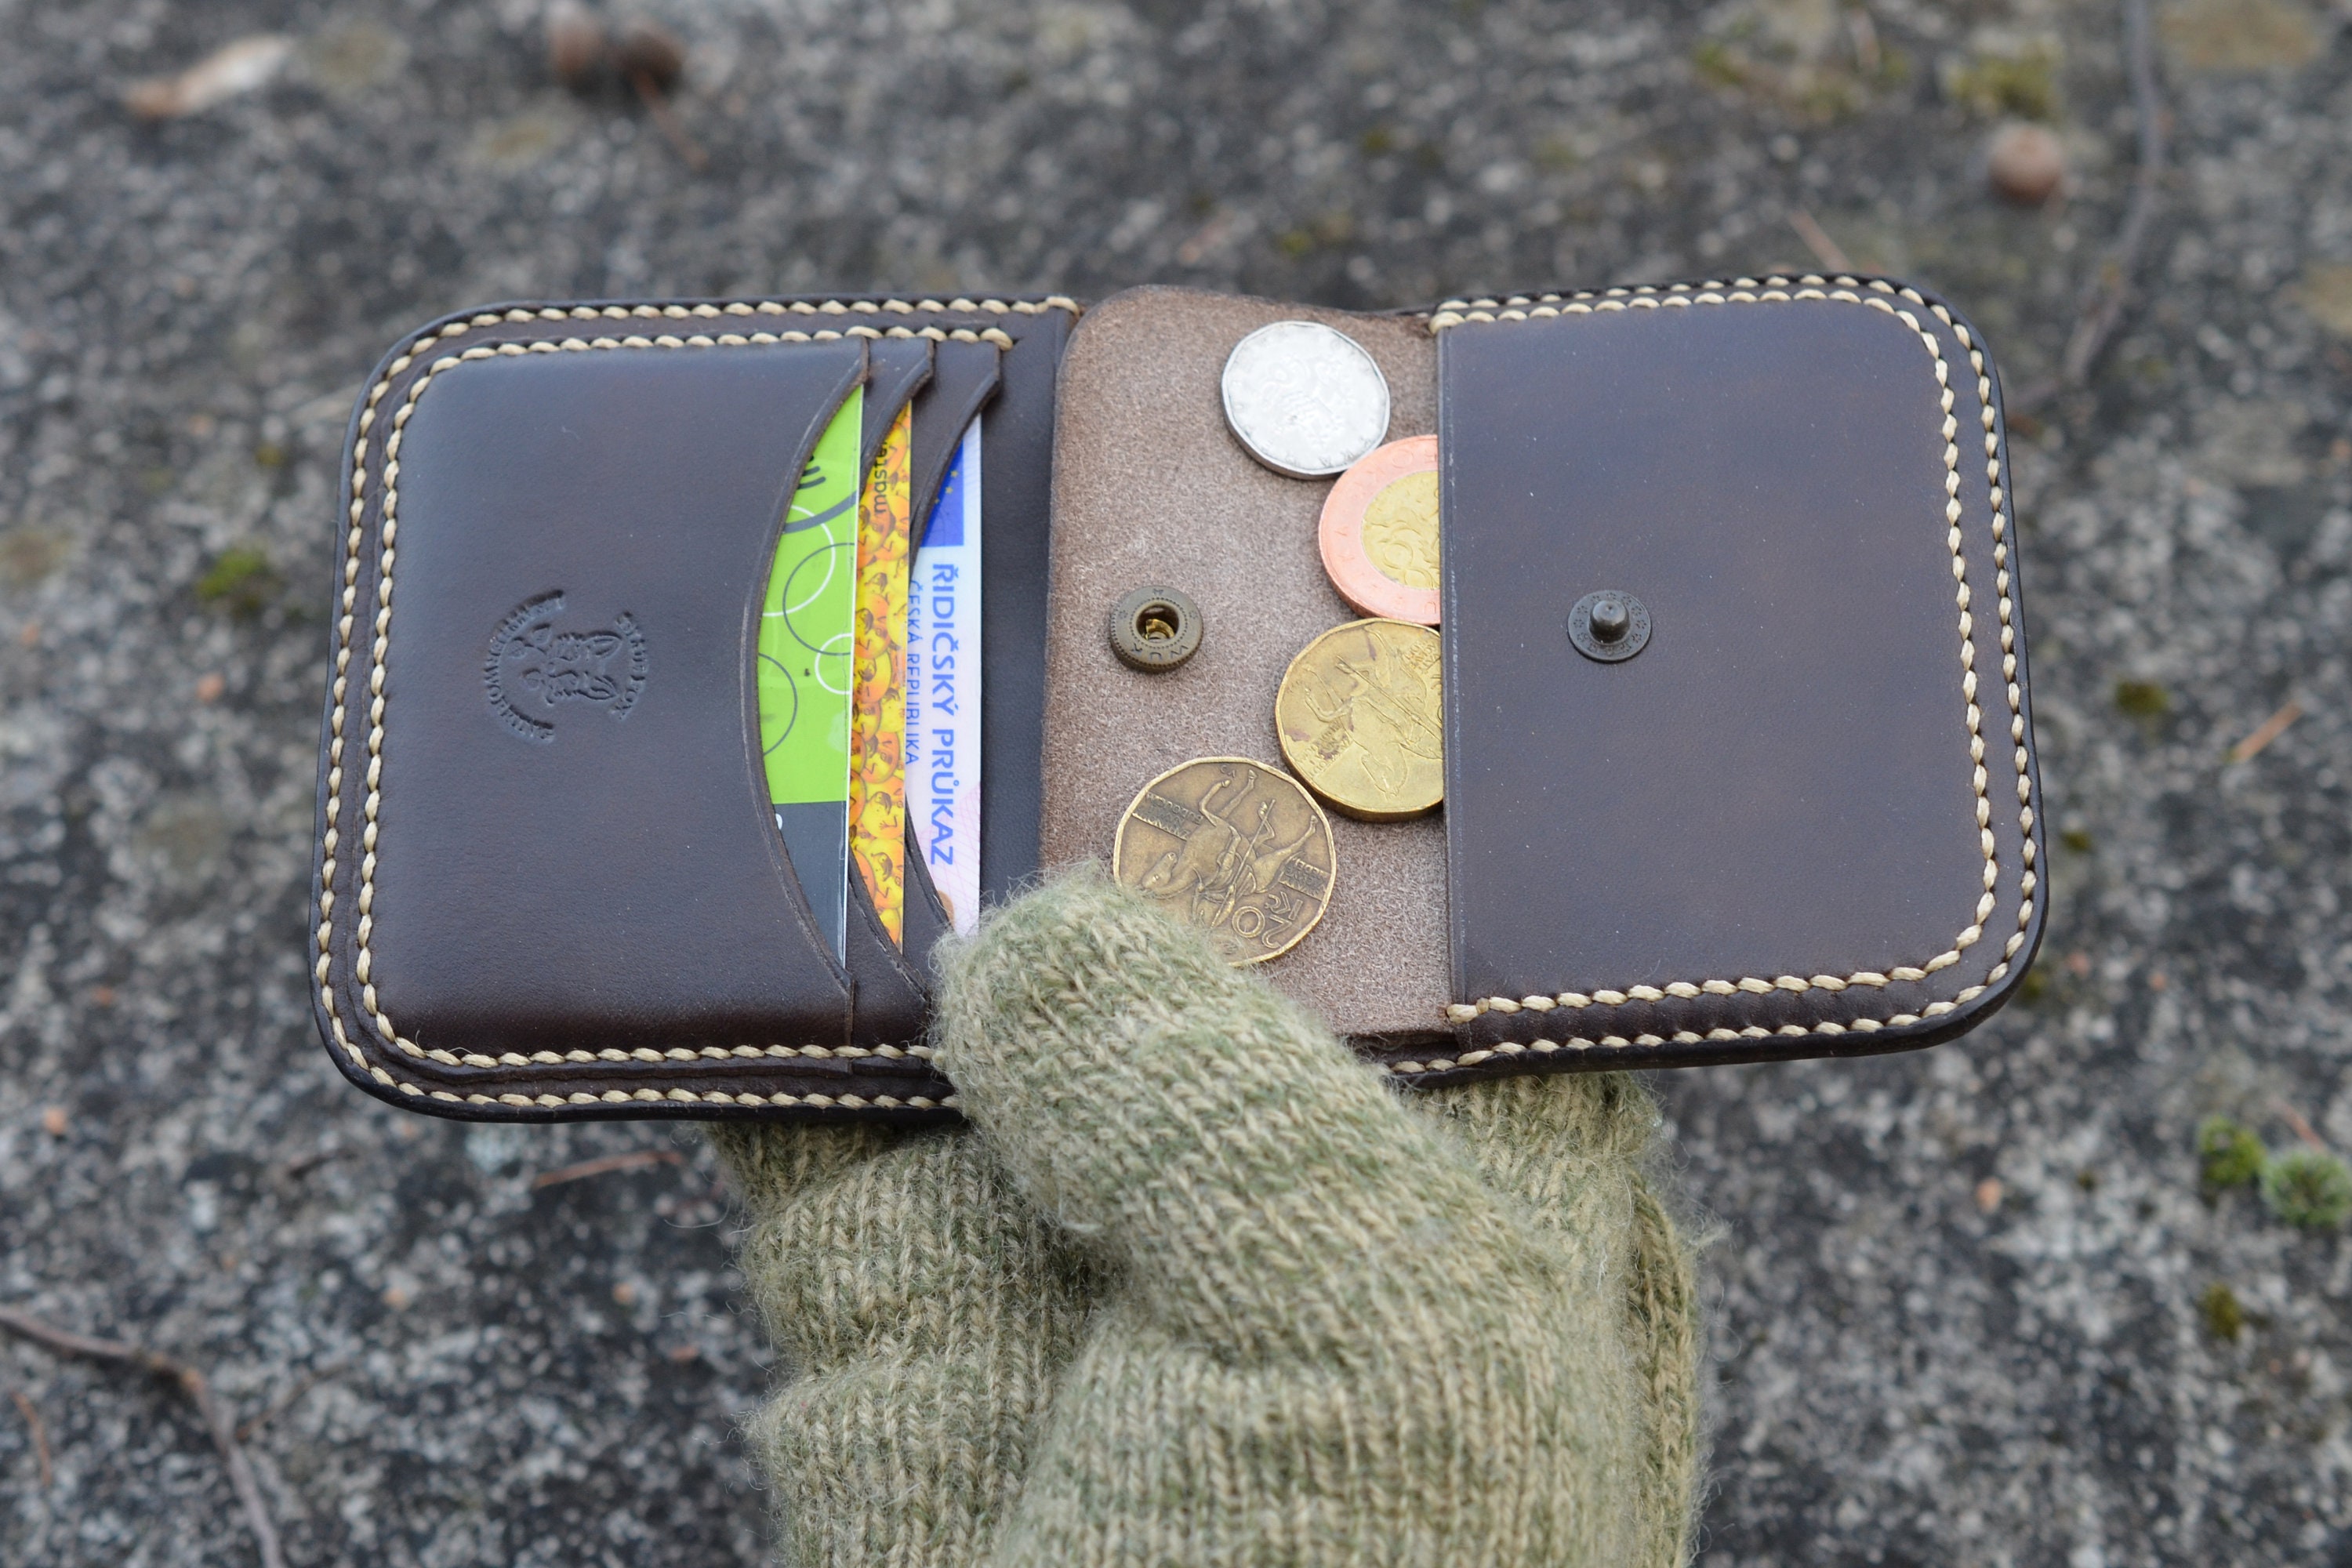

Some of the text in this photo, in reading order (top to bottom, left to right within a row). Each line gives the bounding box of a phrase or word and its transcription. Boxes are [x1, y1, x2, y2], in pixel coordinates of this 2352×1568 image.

[906, 579, 924, 644] ČESKÁ
[930, 564, 960, 866] ŘIDIČSKÝ PRŮKAZ
